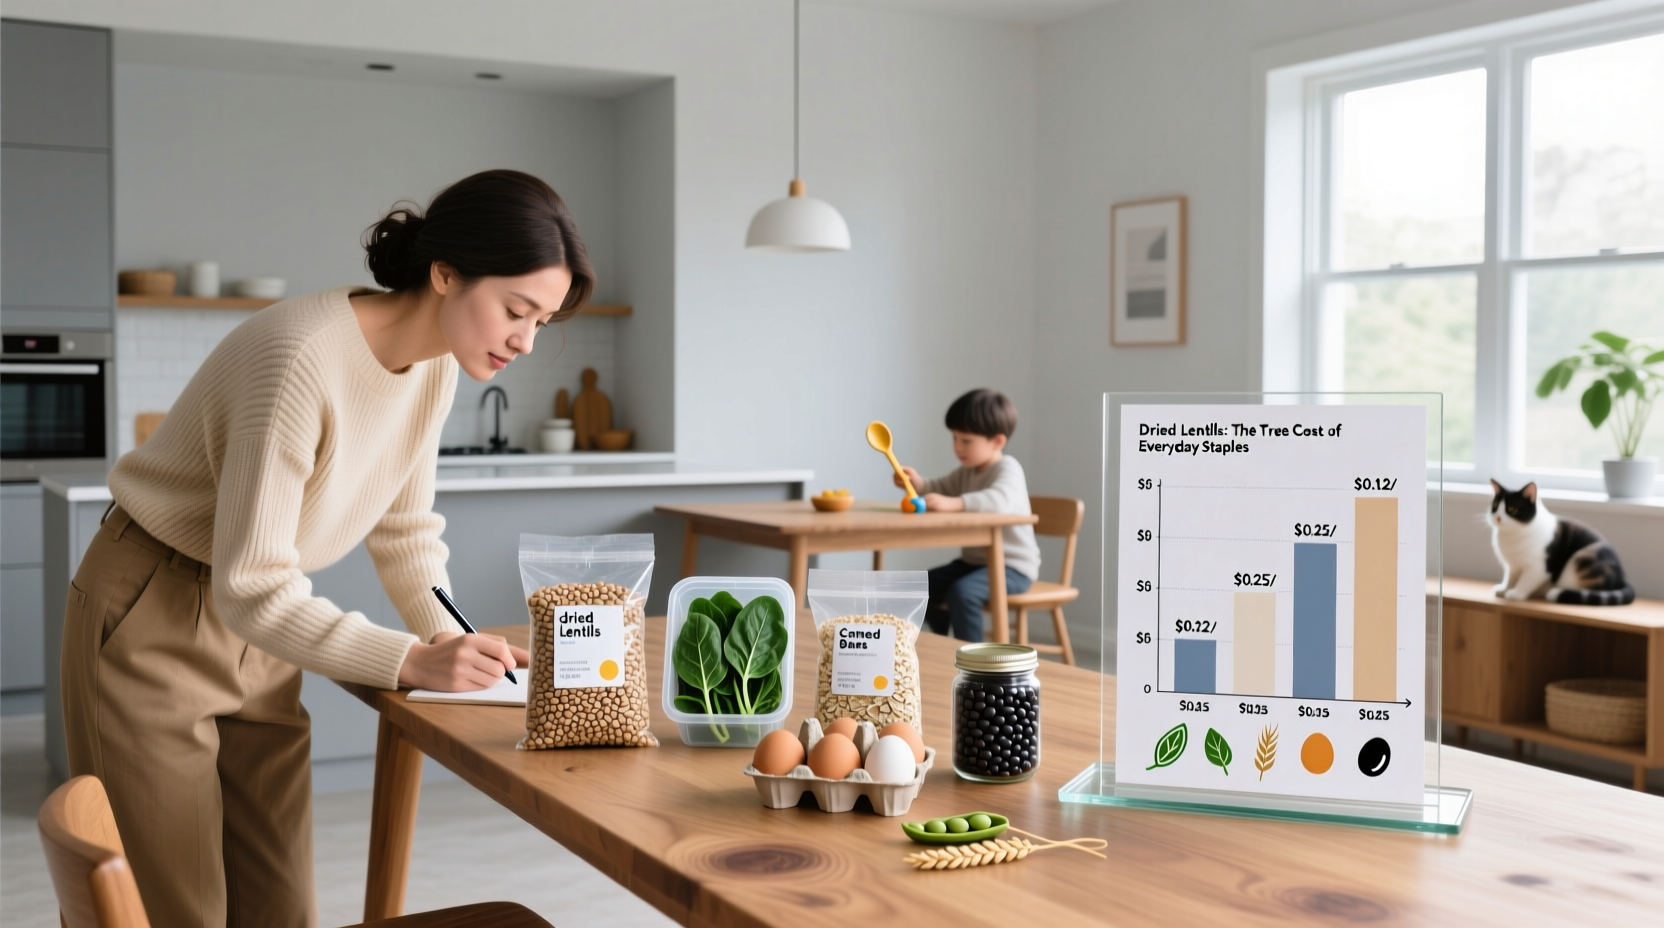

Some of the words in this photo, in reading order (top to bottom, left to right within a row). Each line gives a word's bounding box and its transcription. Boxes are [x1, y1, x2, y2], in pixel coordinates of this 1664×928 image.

[1139, 422, 1177, 437] Dried
[1230, 422, 1257, 437] The
[1292, 423, 1325, 437] Cost
[1327, 422, 1343, 438] of
[1138, 440, 1200, 456] Everyday
[1201, 439, 1250, 456] Staples
[1353, 476, 1398, 492] $0.12/
[1233, 571, 1277, 588] $0.25/
[559, 611, 594, 624] dried
